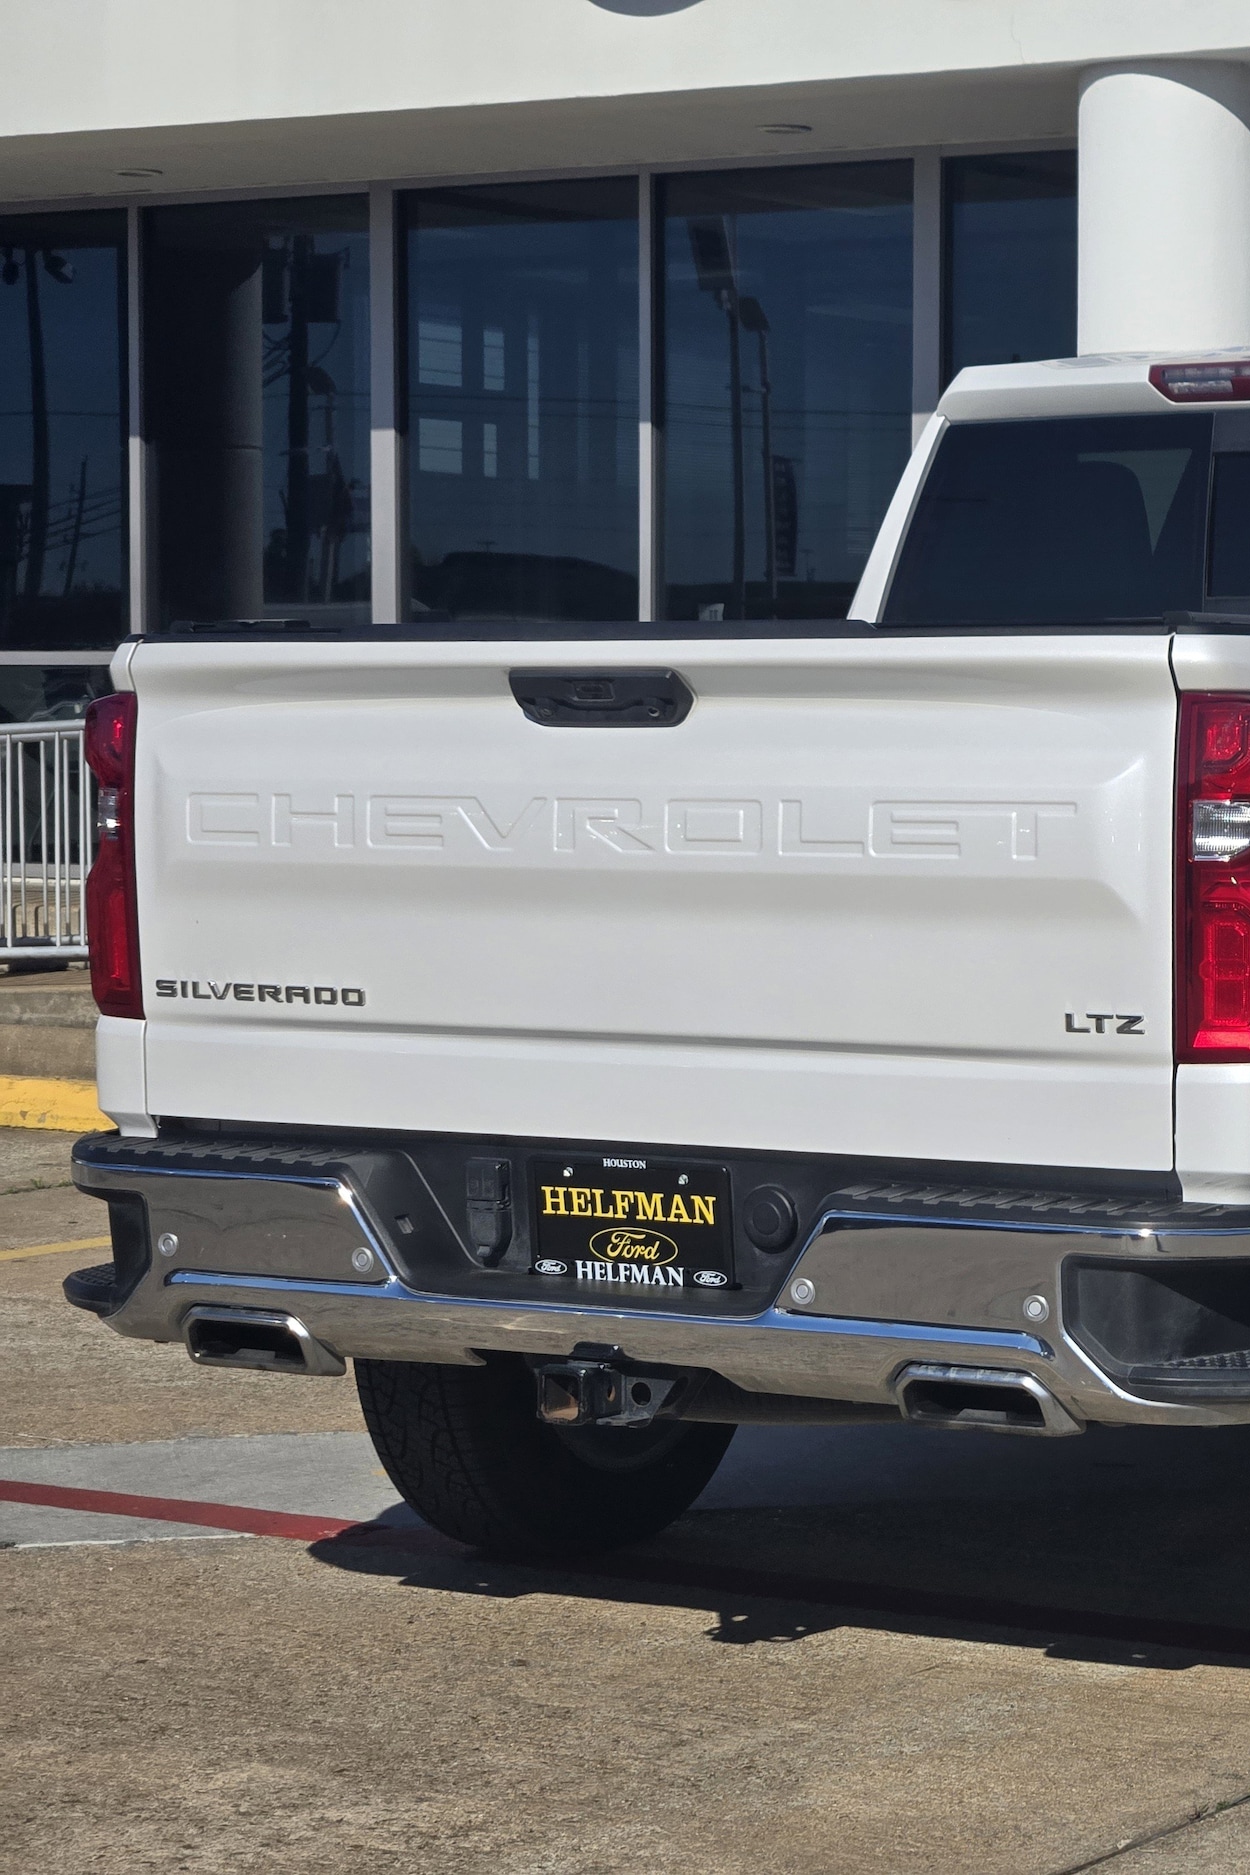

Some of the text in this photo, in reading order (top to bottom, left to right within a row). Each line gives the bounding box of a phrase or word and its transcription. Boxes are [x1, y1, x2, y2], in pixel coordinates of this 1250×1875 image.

[185, 792, 1078, 862] CHEVROLET
[155, 979, 366, 1007] SILVERADO
[1064, 1012, 1146, 1035] LTZ
[602, 1157, 647, 1170] HOUSTON
[540, 1185, 717, 1225] HELFMAN
[606, 1231, 661, 1260] Ford
[575, 1260, 685, 1287] HELFMAN
